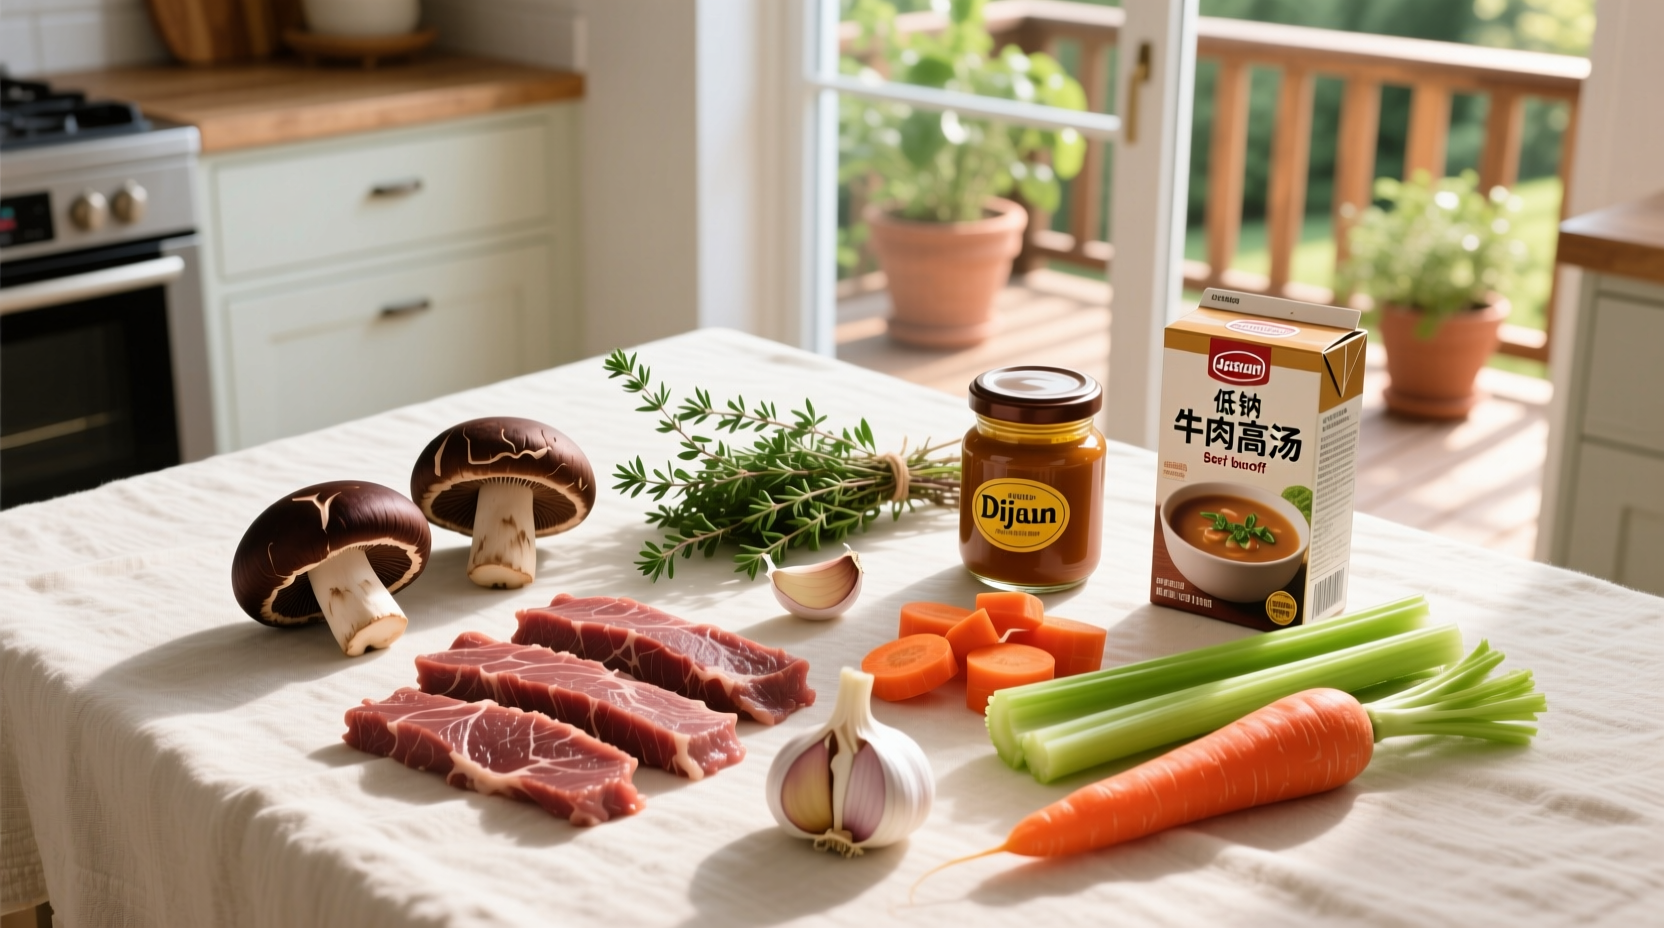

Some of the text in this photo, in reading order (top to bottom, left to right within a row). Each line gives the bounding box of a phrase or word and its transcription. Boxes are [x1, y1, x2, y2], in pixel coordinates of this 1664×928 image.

[1214, 388, 1262, 419] 低钠
[1173, 408, 1303, 462] 牛肉高汤
